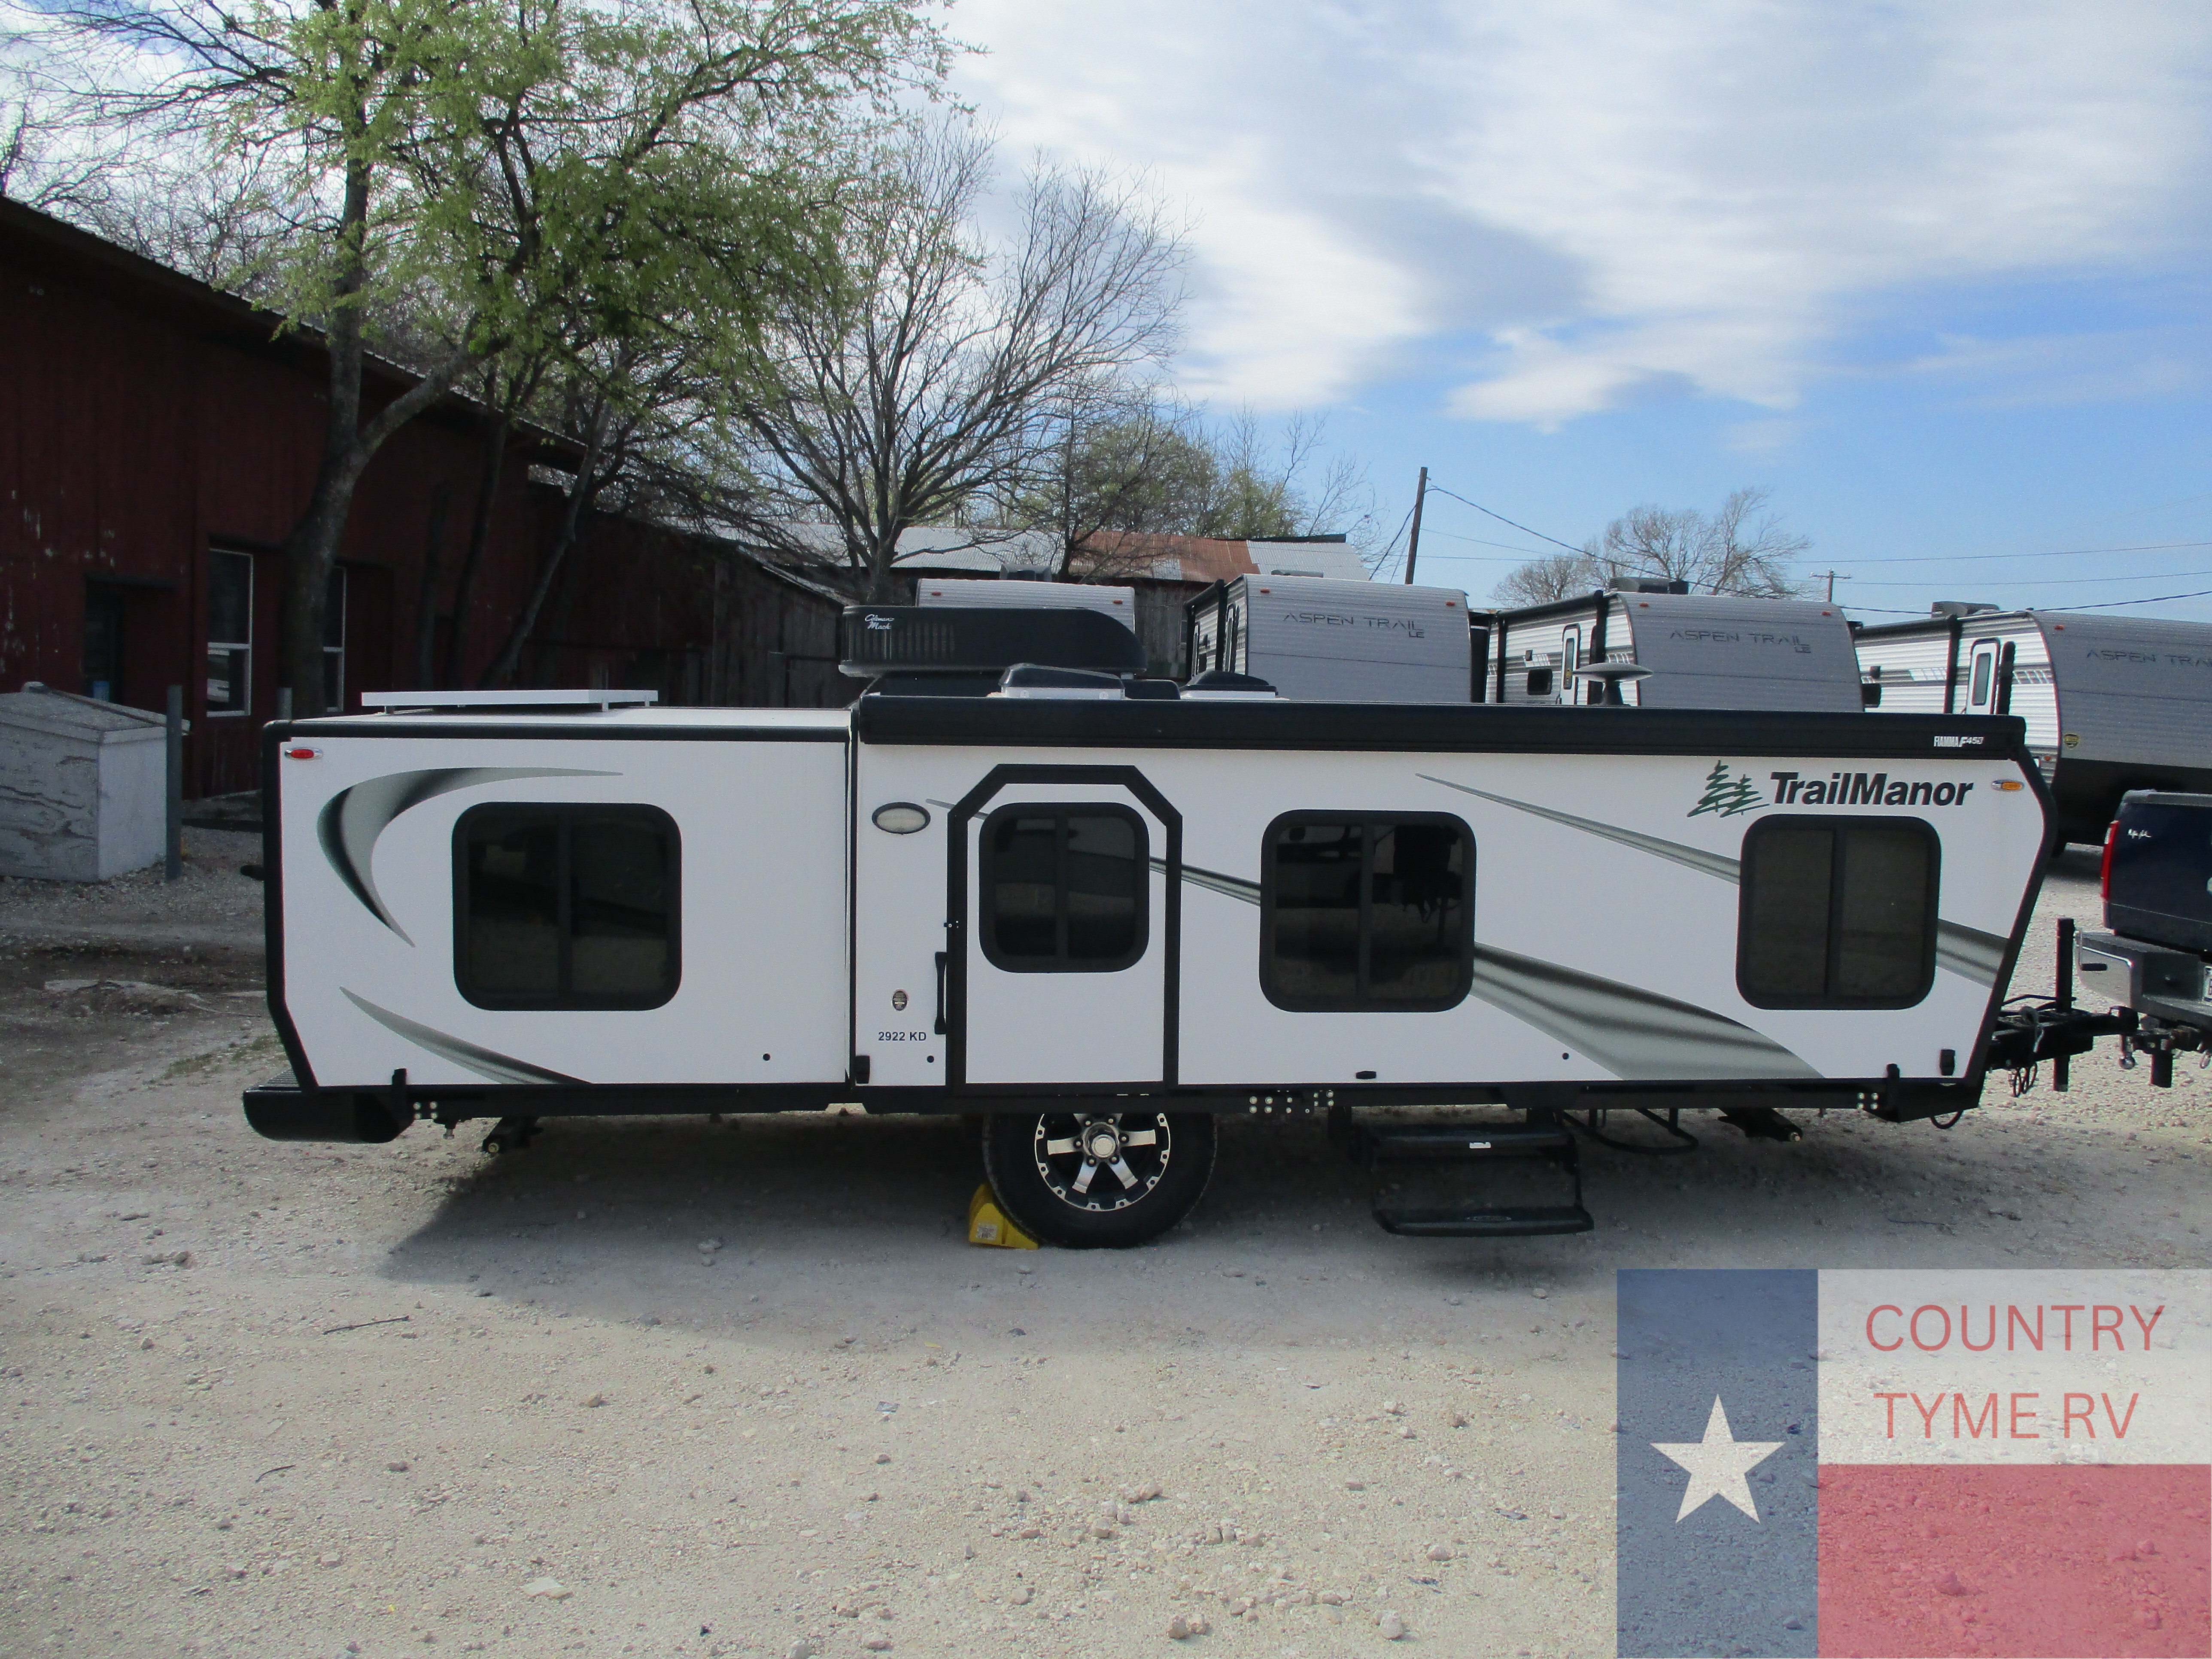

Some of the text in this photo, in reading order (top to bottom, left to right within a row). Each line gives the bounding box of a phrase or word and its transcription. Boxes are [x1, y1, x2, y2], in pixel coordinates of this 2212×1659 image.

[1283, 613, 1424, 630] ASPEN TRAIL
[1669, 630, 1809, 646] ASPEN TRAIL
[2087, 650, 2156, 662] ASPEN
[1770, 771, 1973, 806] TrailManor
[878, 1031, 927, 1041] 2922 KD
